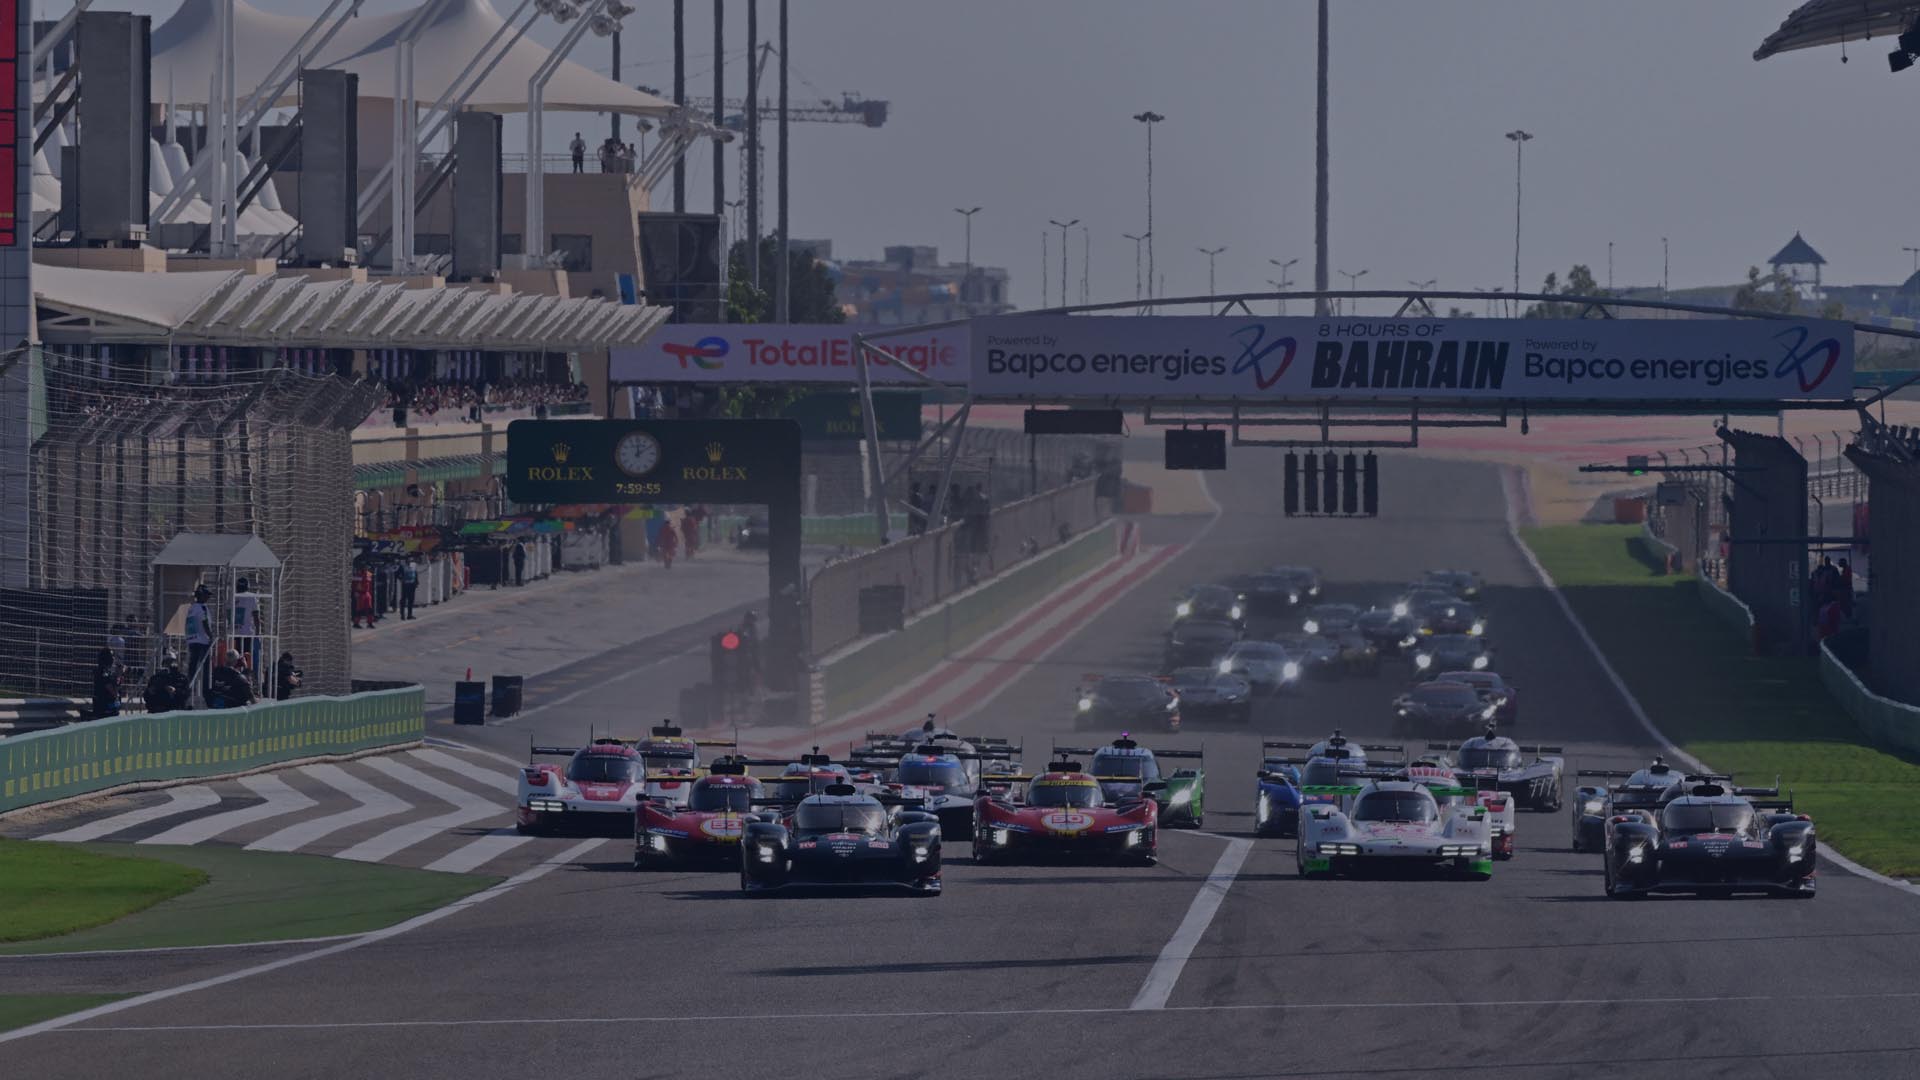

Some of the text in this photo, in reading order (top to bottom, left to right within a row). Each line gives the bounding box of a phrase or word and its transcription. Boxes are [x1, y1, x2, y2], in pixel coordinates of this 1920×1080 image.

[1318, 323, 1446, 337] 8 HOURS OF
[987, 335, 1058, 348] Powered by
[1525, 338, 1597, 353] Powered by
[987, 348, 1227, 381] Bapco energies
[1311, 340, 1510, 389] BAHRAIN
[1525, 352, 1769, 386] Bapco energies
[528, 466, 593, 480] ROLEX
[682, 466, 747, 480] ROLEX
[615, 482, 662, 495] 7:59:55
